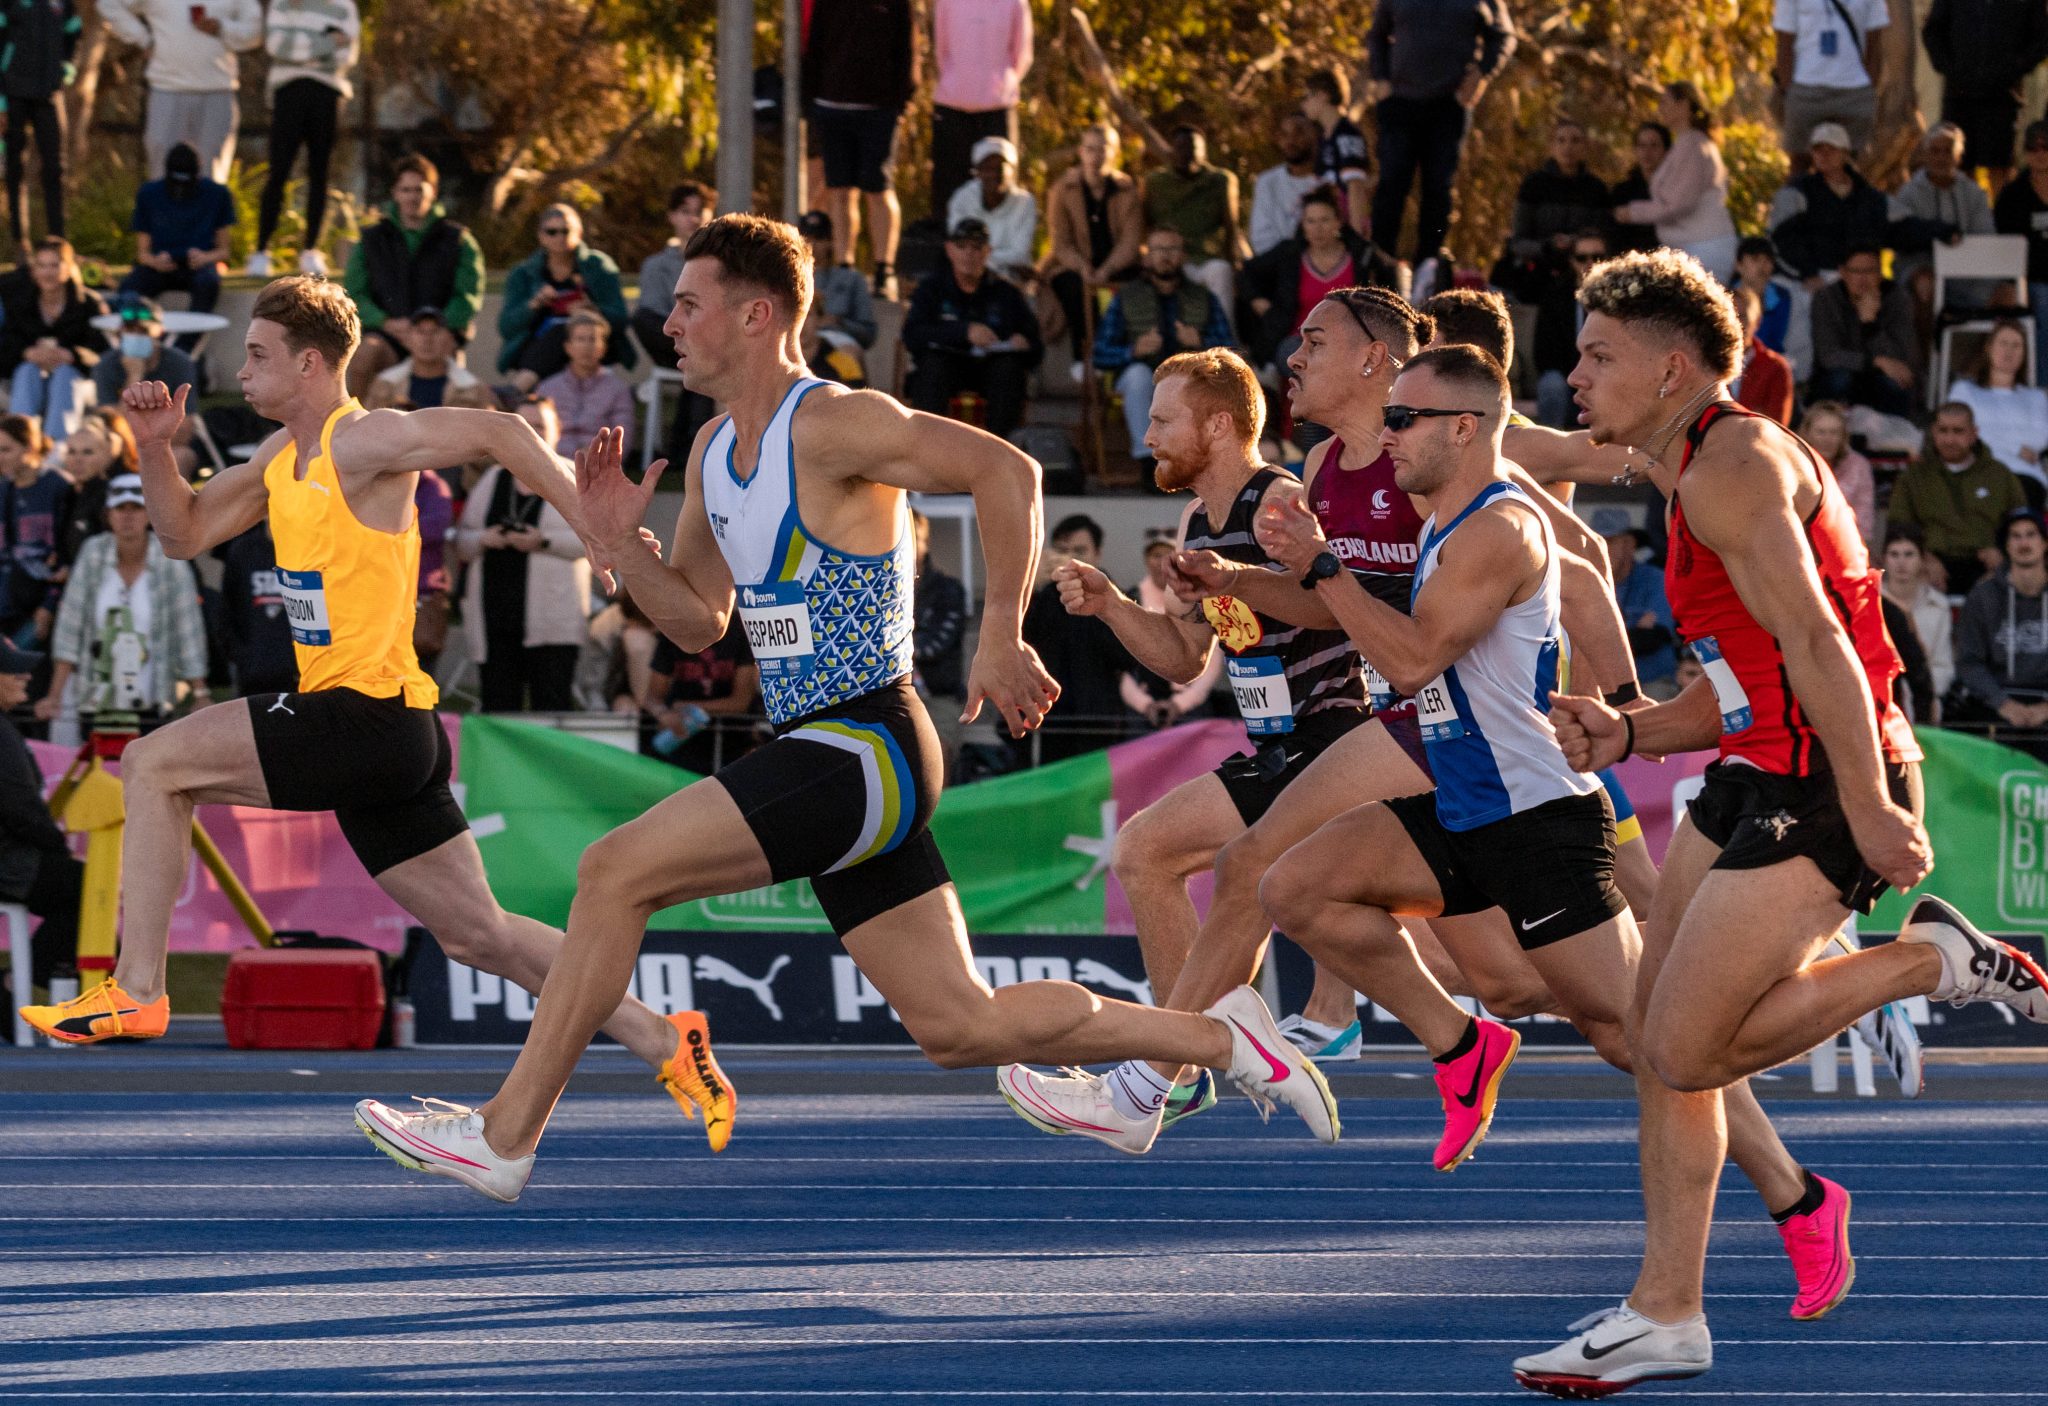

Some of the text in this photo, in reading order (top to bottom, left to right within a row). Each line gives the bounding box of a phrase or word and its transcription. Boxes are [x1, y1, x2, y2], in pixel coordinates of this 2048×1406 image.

[1327, 537, 1418, 564] EENSLAND
[755, 592, 777, 604] SOUTH
[1240, 666, 1258, 675] SOUTH
[448, 953, 695, 1022] PA
[687, 1029, 725, 1102] NITRO
